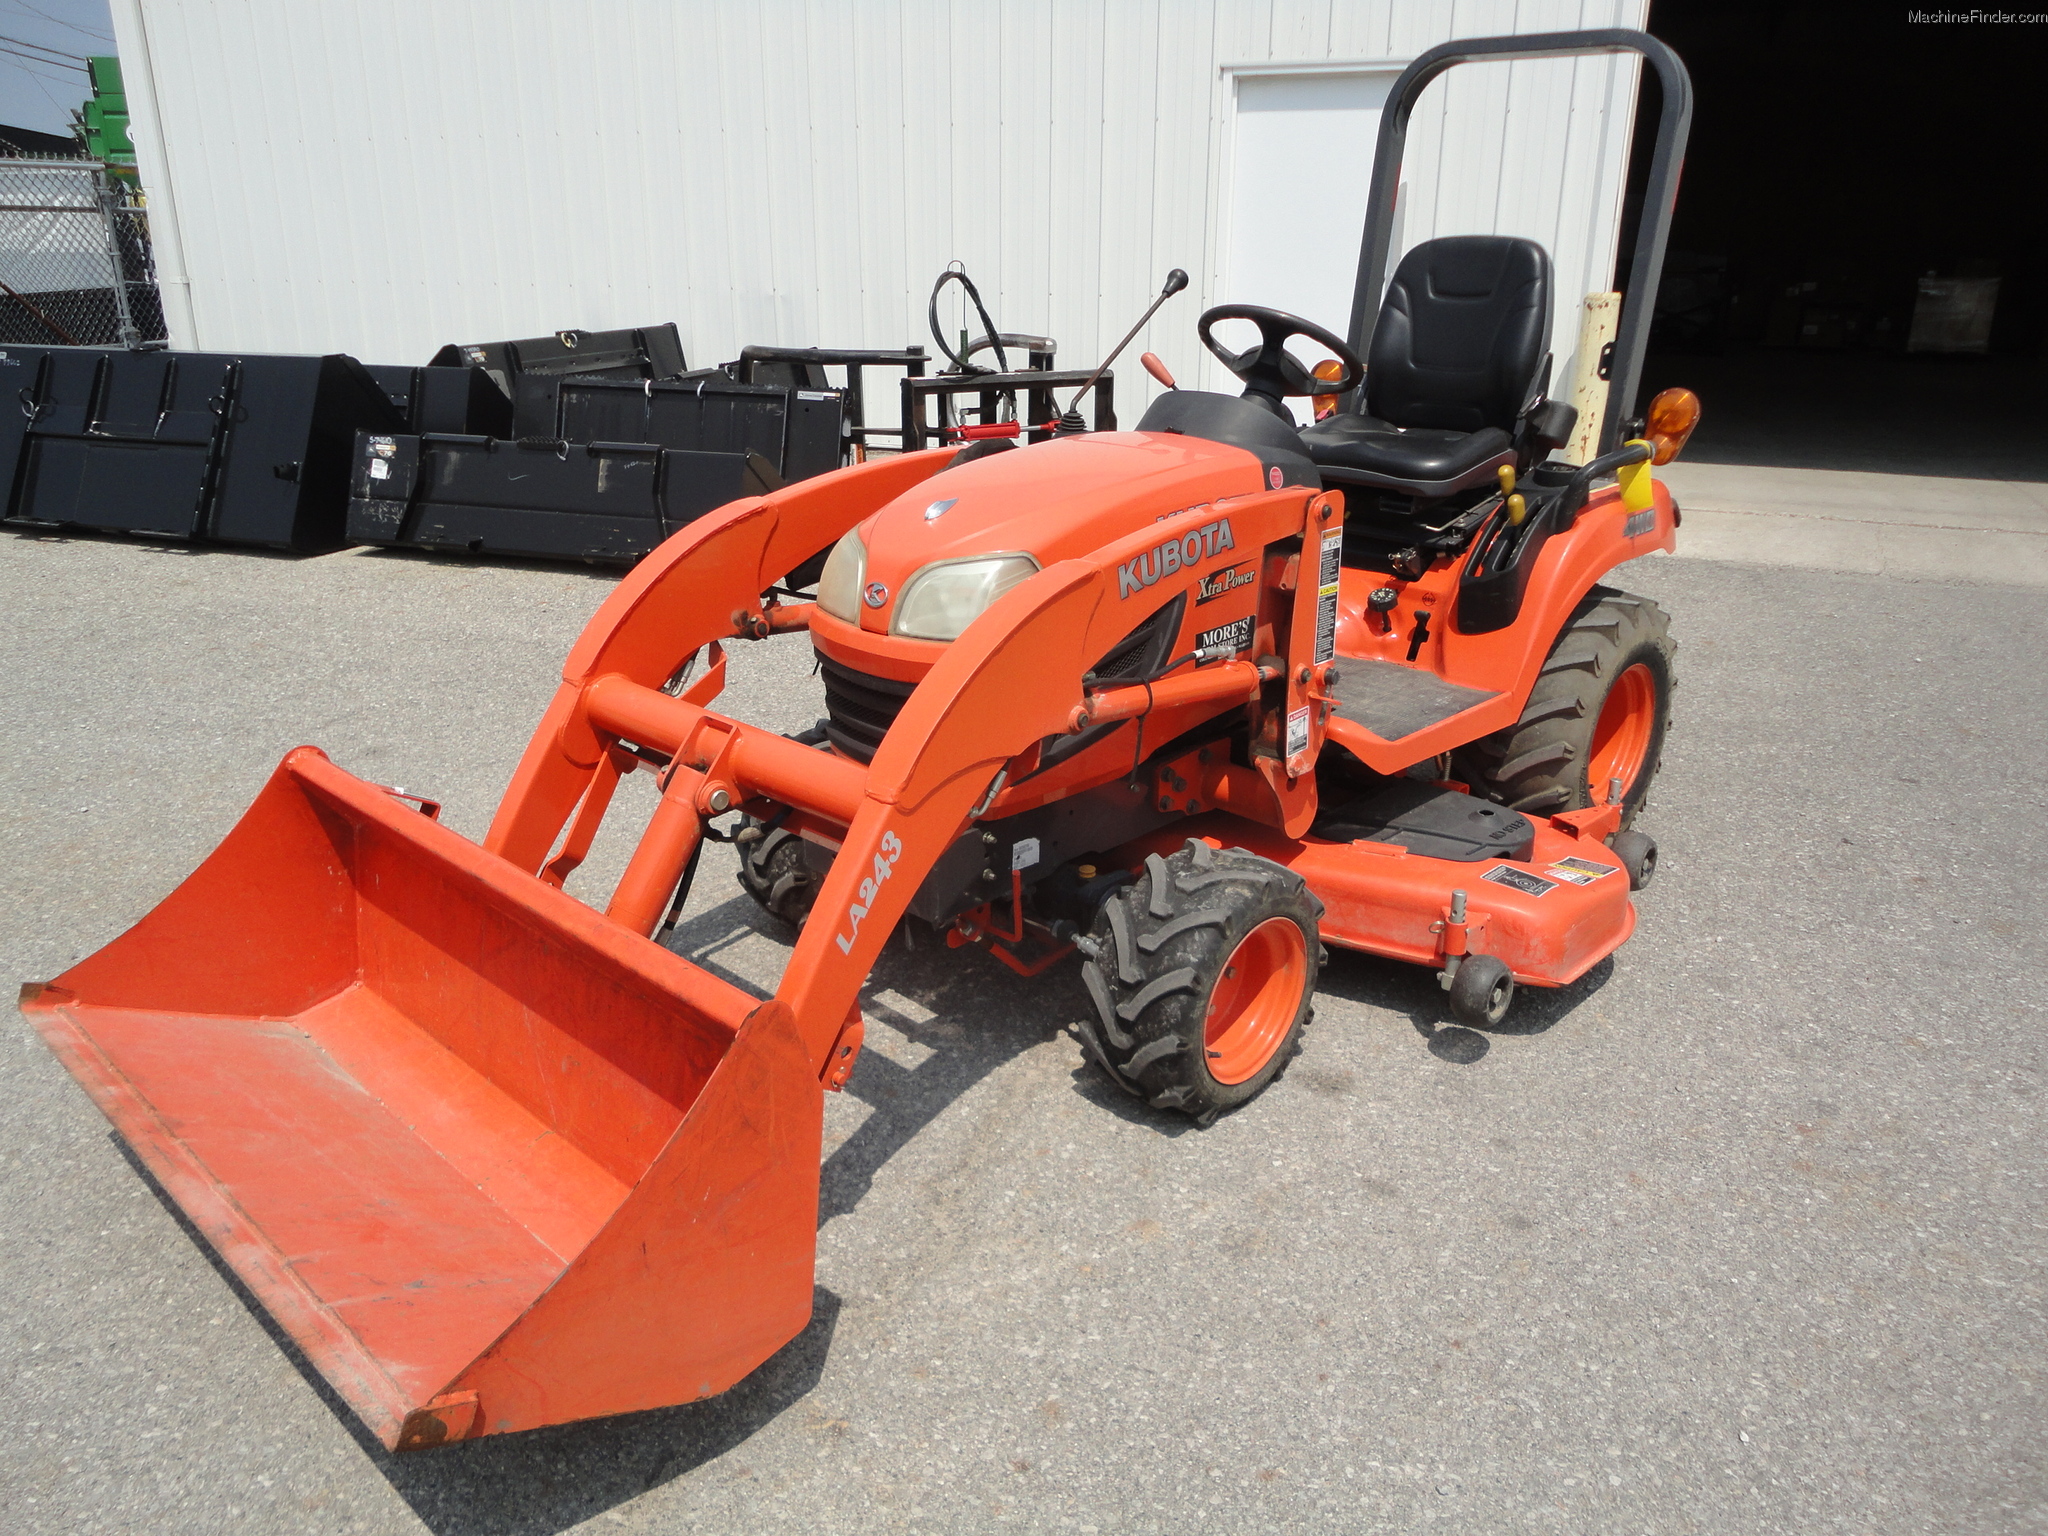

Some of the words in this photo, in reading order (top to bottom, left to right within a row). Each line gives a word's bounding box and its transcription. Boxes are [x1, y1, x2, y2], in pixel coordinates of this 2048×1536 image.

[1117, 518, 1235, 600] KUBOTA
[1196, 576, 1222, 600] Xtra
[1223, 568, 1255, 591] Power
[1202, 619, 1249, 648] MORE'S
[835, 830, 902, 956] LA243
